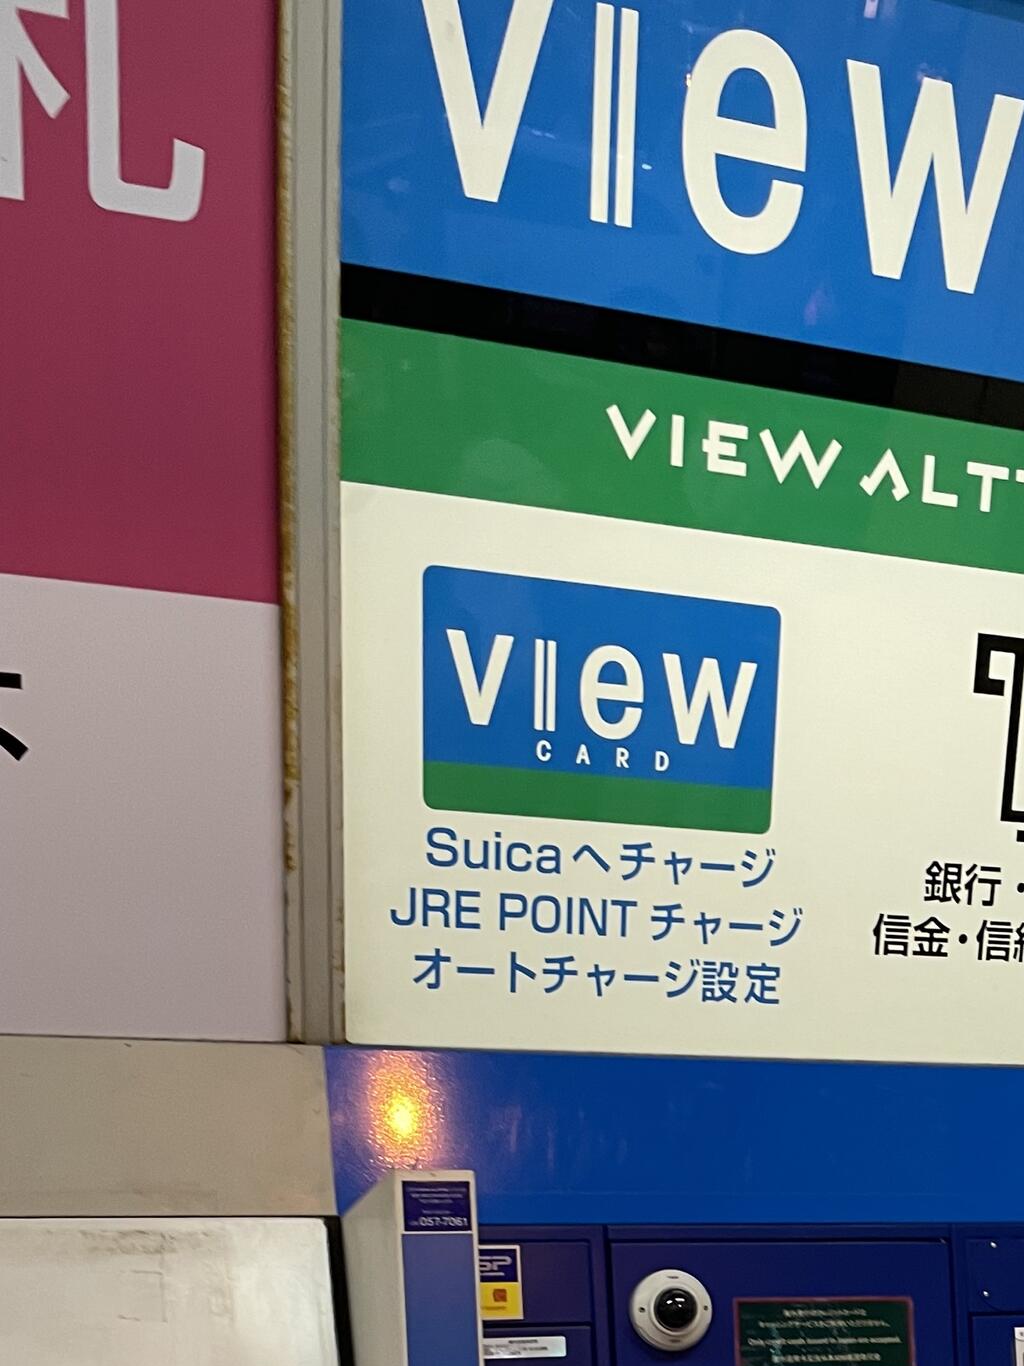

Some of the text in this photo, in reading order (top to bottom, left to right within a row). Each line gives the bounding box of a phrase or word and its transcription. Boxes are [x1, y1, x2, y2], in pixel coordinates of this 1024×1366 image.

[605, 404, 842, 489] VIEW
[535, 740, 670, 772] CARD
[390, 886, 804, 948] JRE POINT チャージ
[412, 947, 782, 1005] オートチャージ設定
